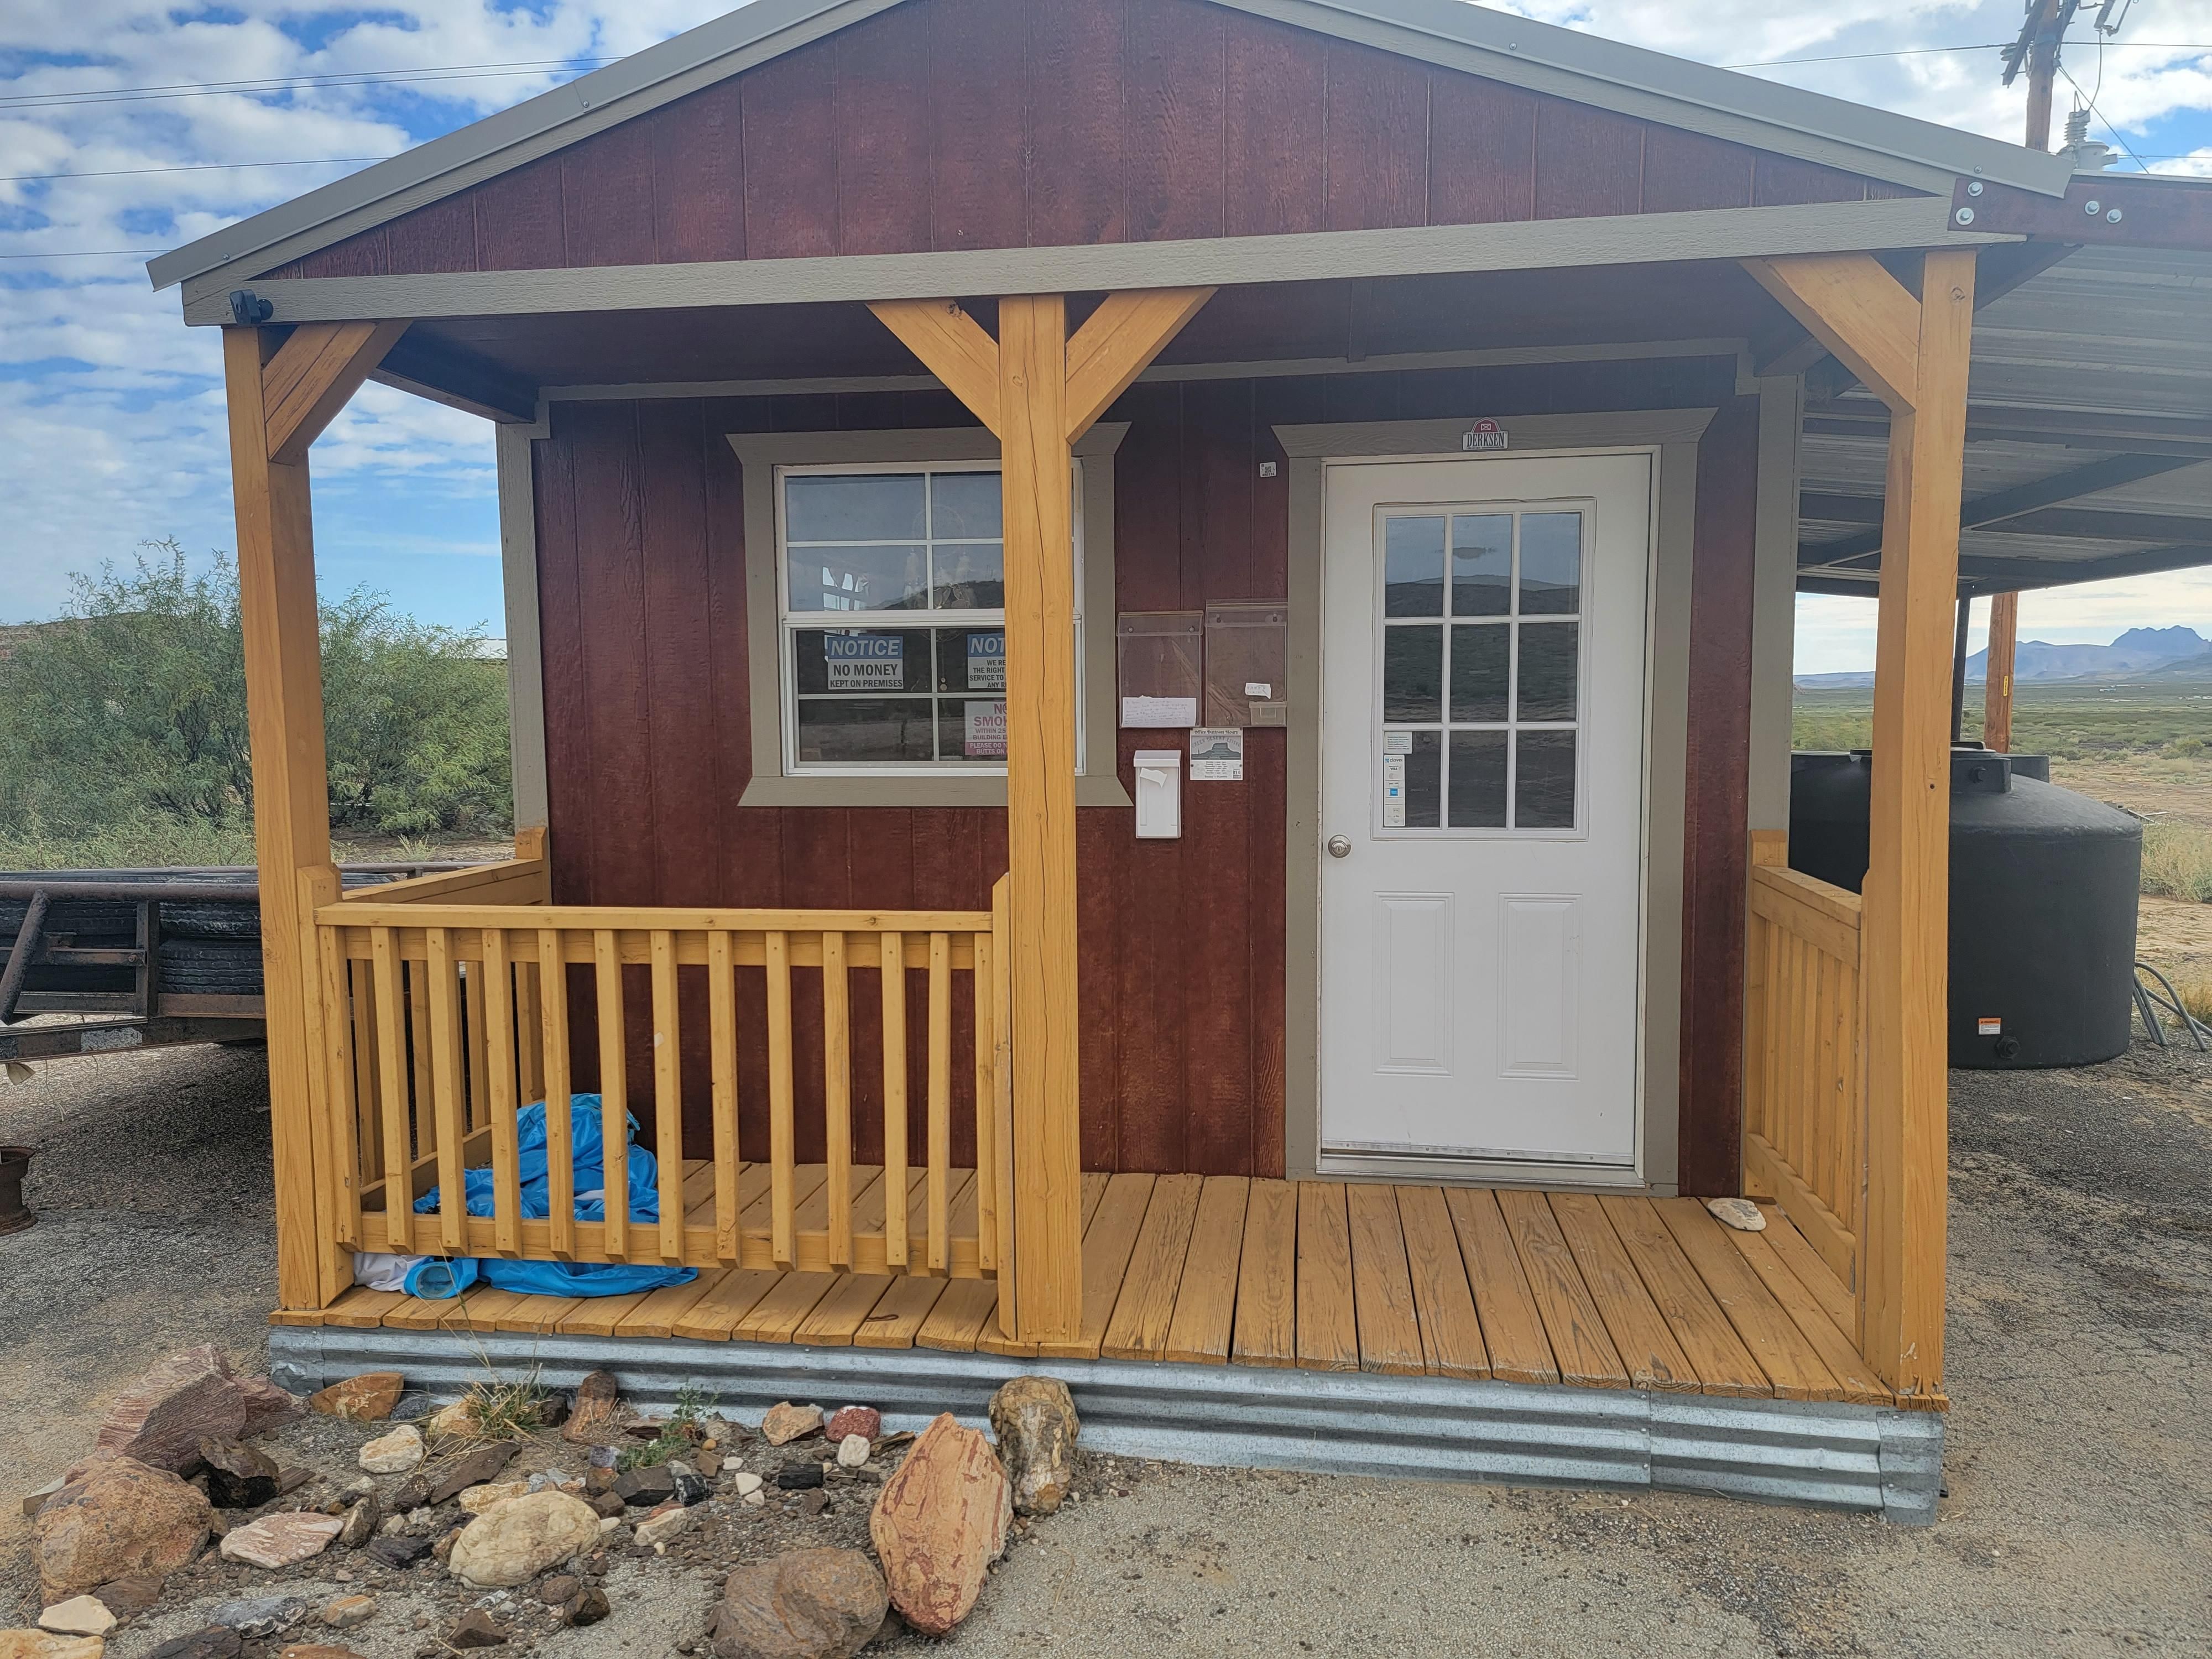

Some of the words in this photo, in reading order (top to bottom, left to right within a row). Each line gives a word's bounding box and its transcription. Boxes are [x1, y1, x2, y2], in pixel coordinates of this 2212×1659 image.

[1467, 432, 1505, 447] DERKSEN
[831, 640, 900, 656] NOTICE
[833, 664, 851, 676] NO
[854, 664, 898, 676] MONEY
